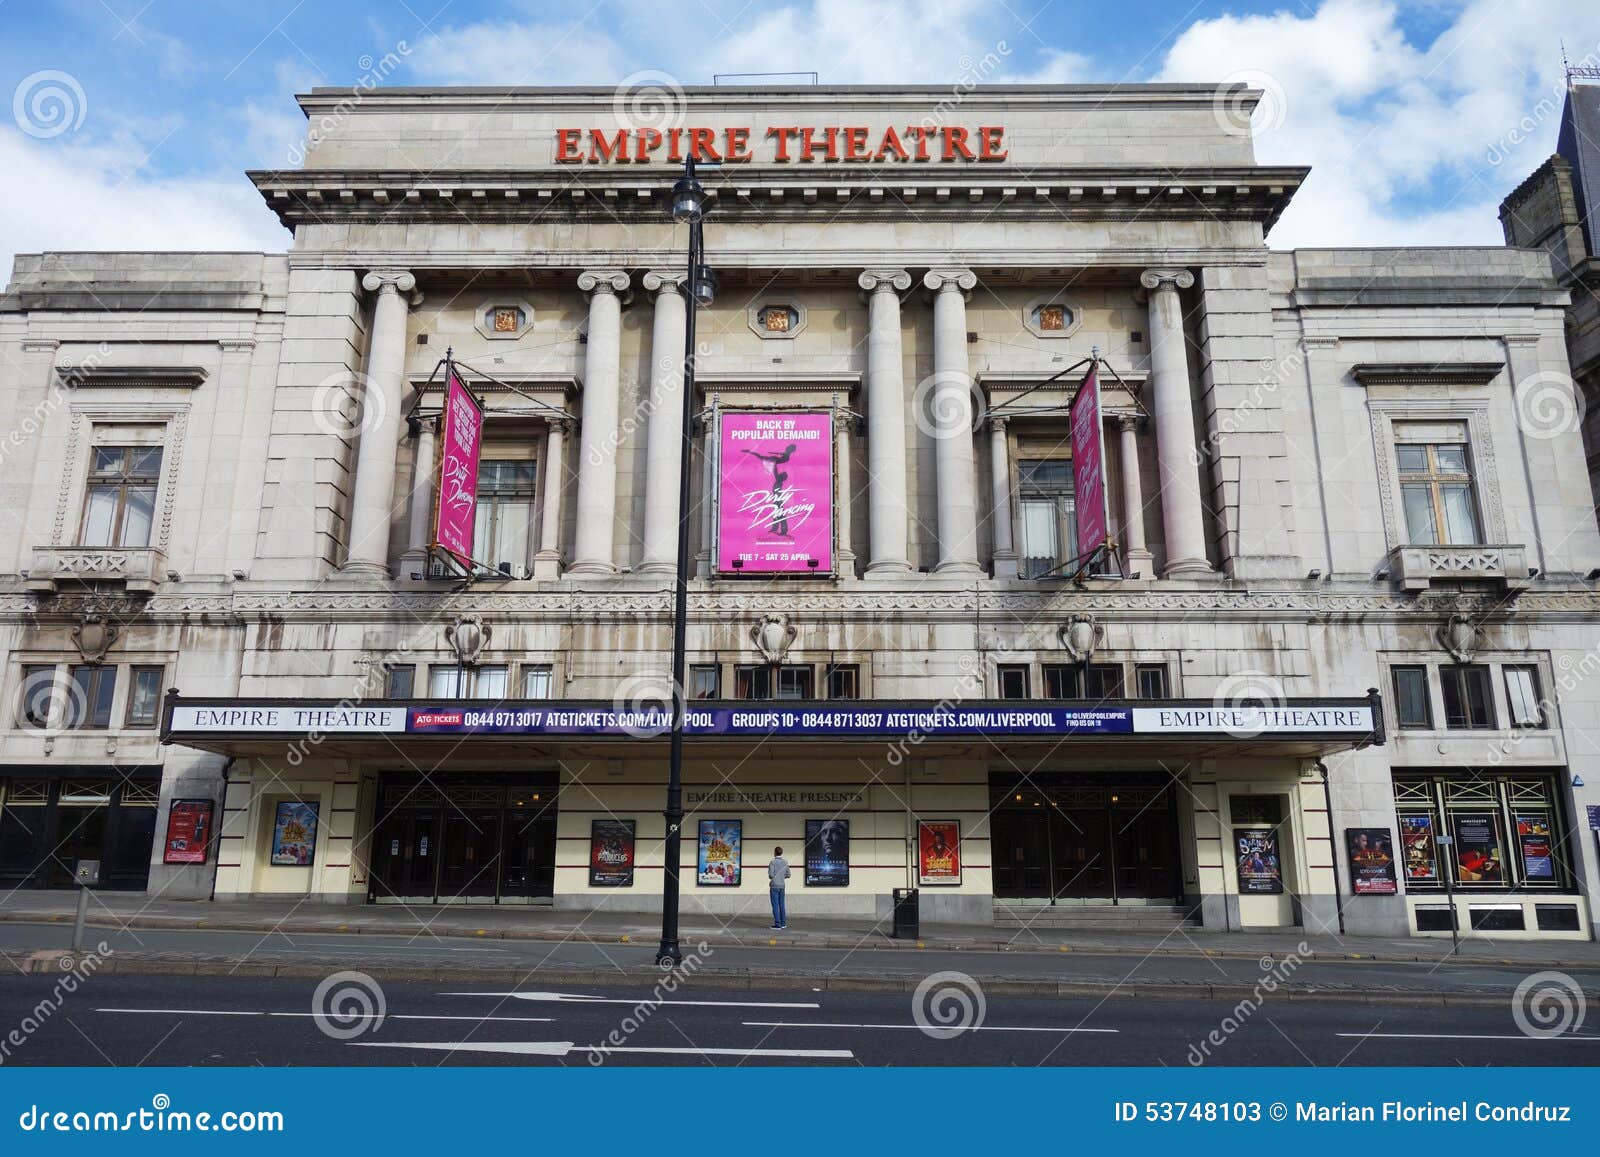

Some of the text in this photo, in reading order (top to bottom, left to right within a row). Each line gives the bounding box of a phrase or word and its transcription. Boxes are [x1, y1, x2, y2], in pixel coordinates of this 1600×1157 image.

[554, 125, 1009, 164] EMPIRE THEATRE
[756, 420, 796, 430] BACK BY
[732, 430, 820, 440] POPULAR DEMAND!
[737, 484, 808, 512] Dirty
[746, 498, 815, 530] Dancing
[195, 710, 392, 726] EMPIRE THEATRE
[416, 714, 460, 724] ATG TICKETS
[546, 712, 714, 727] ATGTICKETS.COM/LIVEPOOL
[732, 712, 779, 727] GROUPS
[782, 712, 800, 727] 10+
[886, 712, 1056, 727] ATGTICKETS.COM/LIVERPOOL
[1160, 710, 1362, 727] EMPIRE THEATRE
[687, 792, 862, 802] EMPIRE THEATRE PRESENTS
